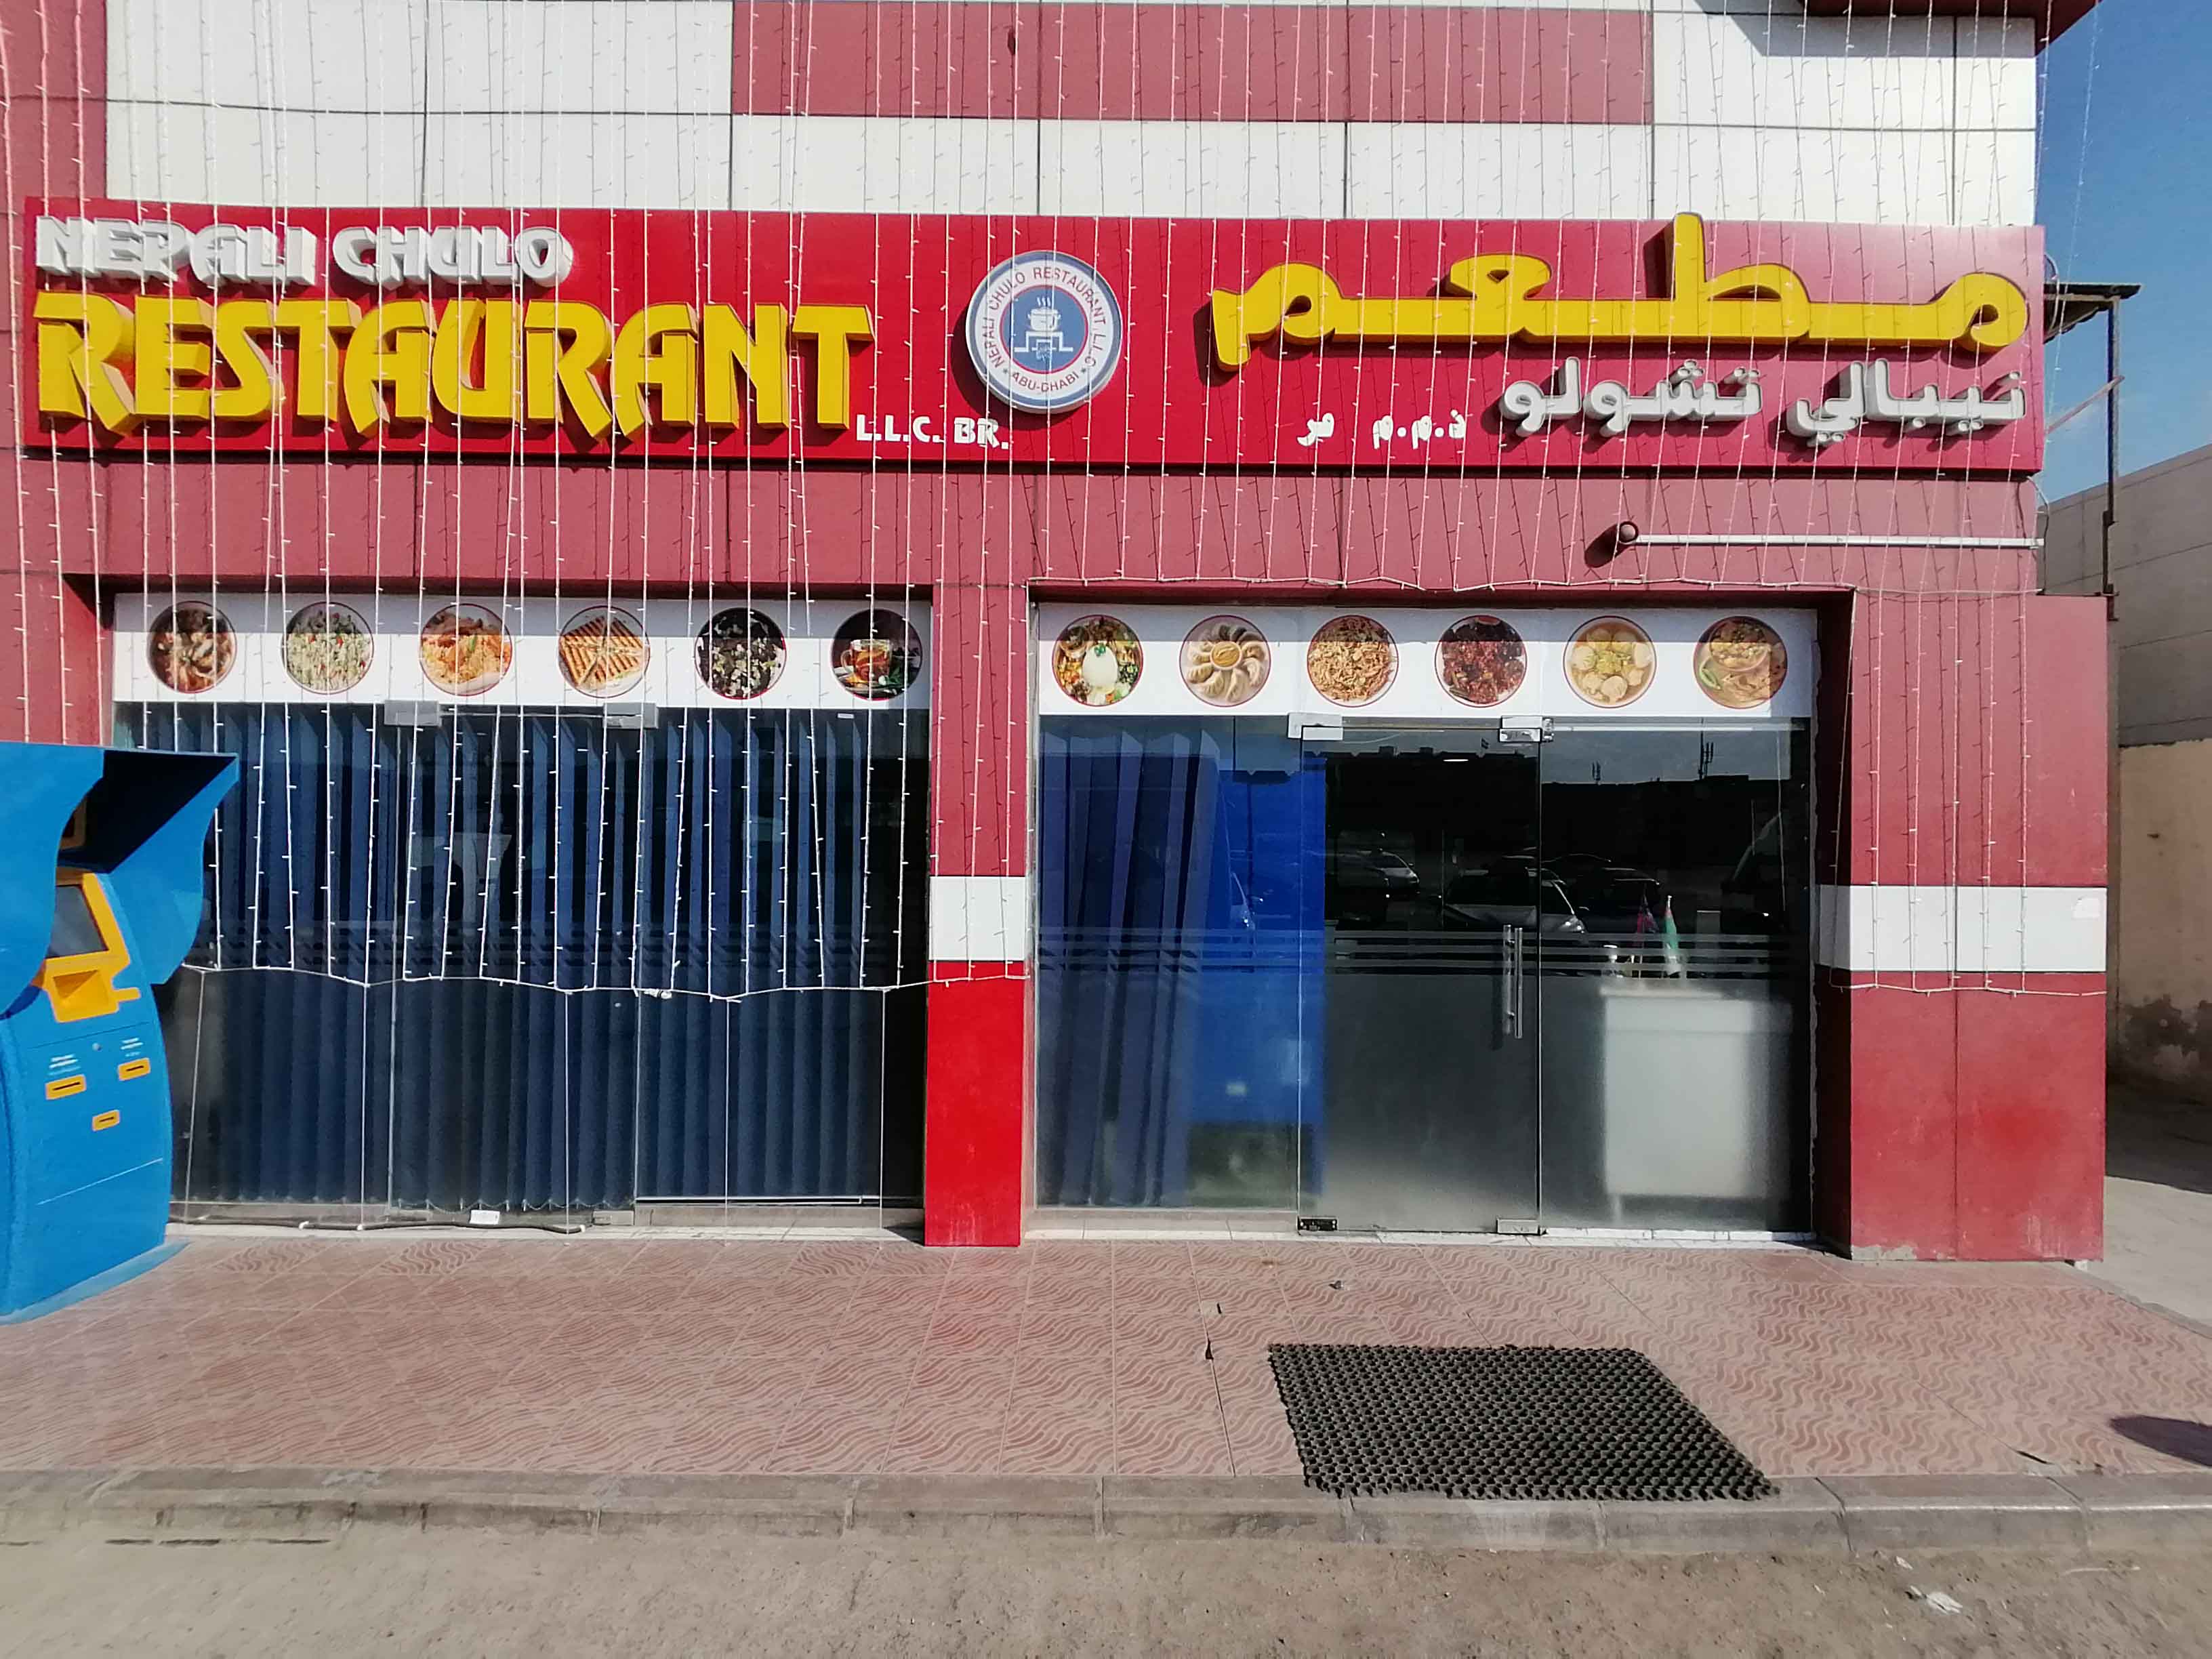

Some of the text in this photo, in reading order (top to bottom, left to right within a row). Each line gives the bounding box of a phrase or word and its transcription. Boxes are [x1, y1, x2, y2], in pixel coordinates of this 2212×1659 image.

[36, 216, 573, 289] NEPALI CHULO
[989, 272, 1025, 310] CHULO
[1033, 266, 1106, 325] RESTAURANT
[1211, 211, 2029, 372] مطعم
[34, 290, 1009, 450] RESTAURANT L.L.C. BR.
[982, 316, 1005, 368] NEPALI
[1499, 356, 1762, 437] تشولو
[1787, 357, 2026, 447] نيبالي
